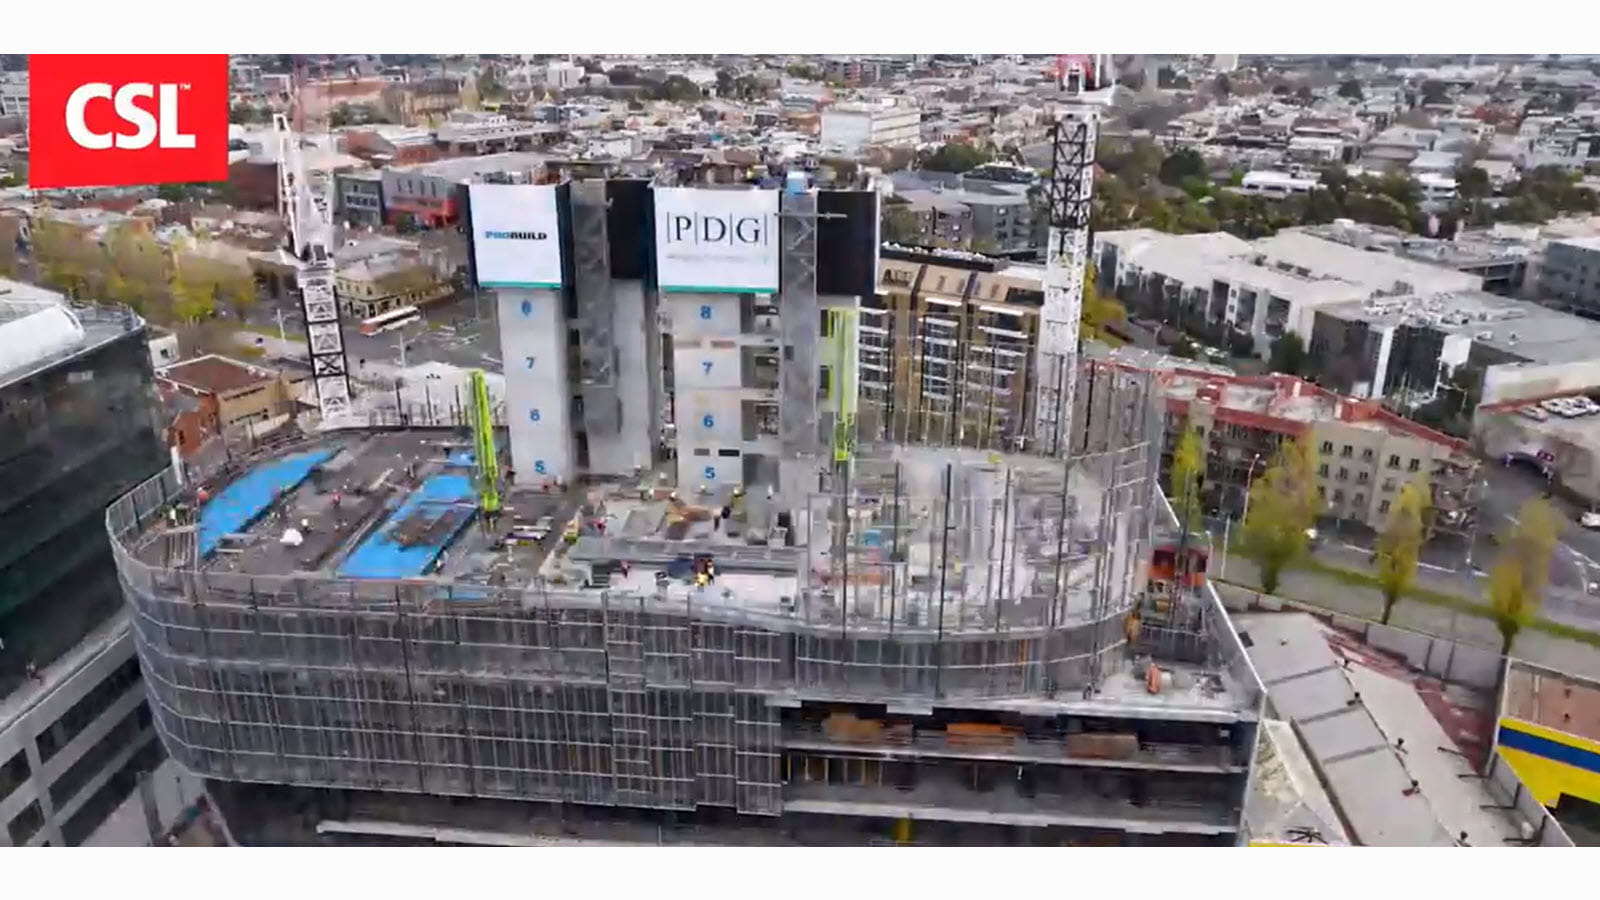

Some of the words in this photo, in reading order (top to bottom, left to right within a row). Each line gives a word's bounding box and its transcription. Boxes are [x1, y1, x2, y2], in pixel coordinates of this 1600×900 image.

[700, 305, 712, 320] 8
[525, 356, 537, 370] 7
[702, 360, 714, 375] 7
[703, 413, 715, 428] 6
[533, 459, 546, 474] 5
[704, 466, 716, 480] 5
